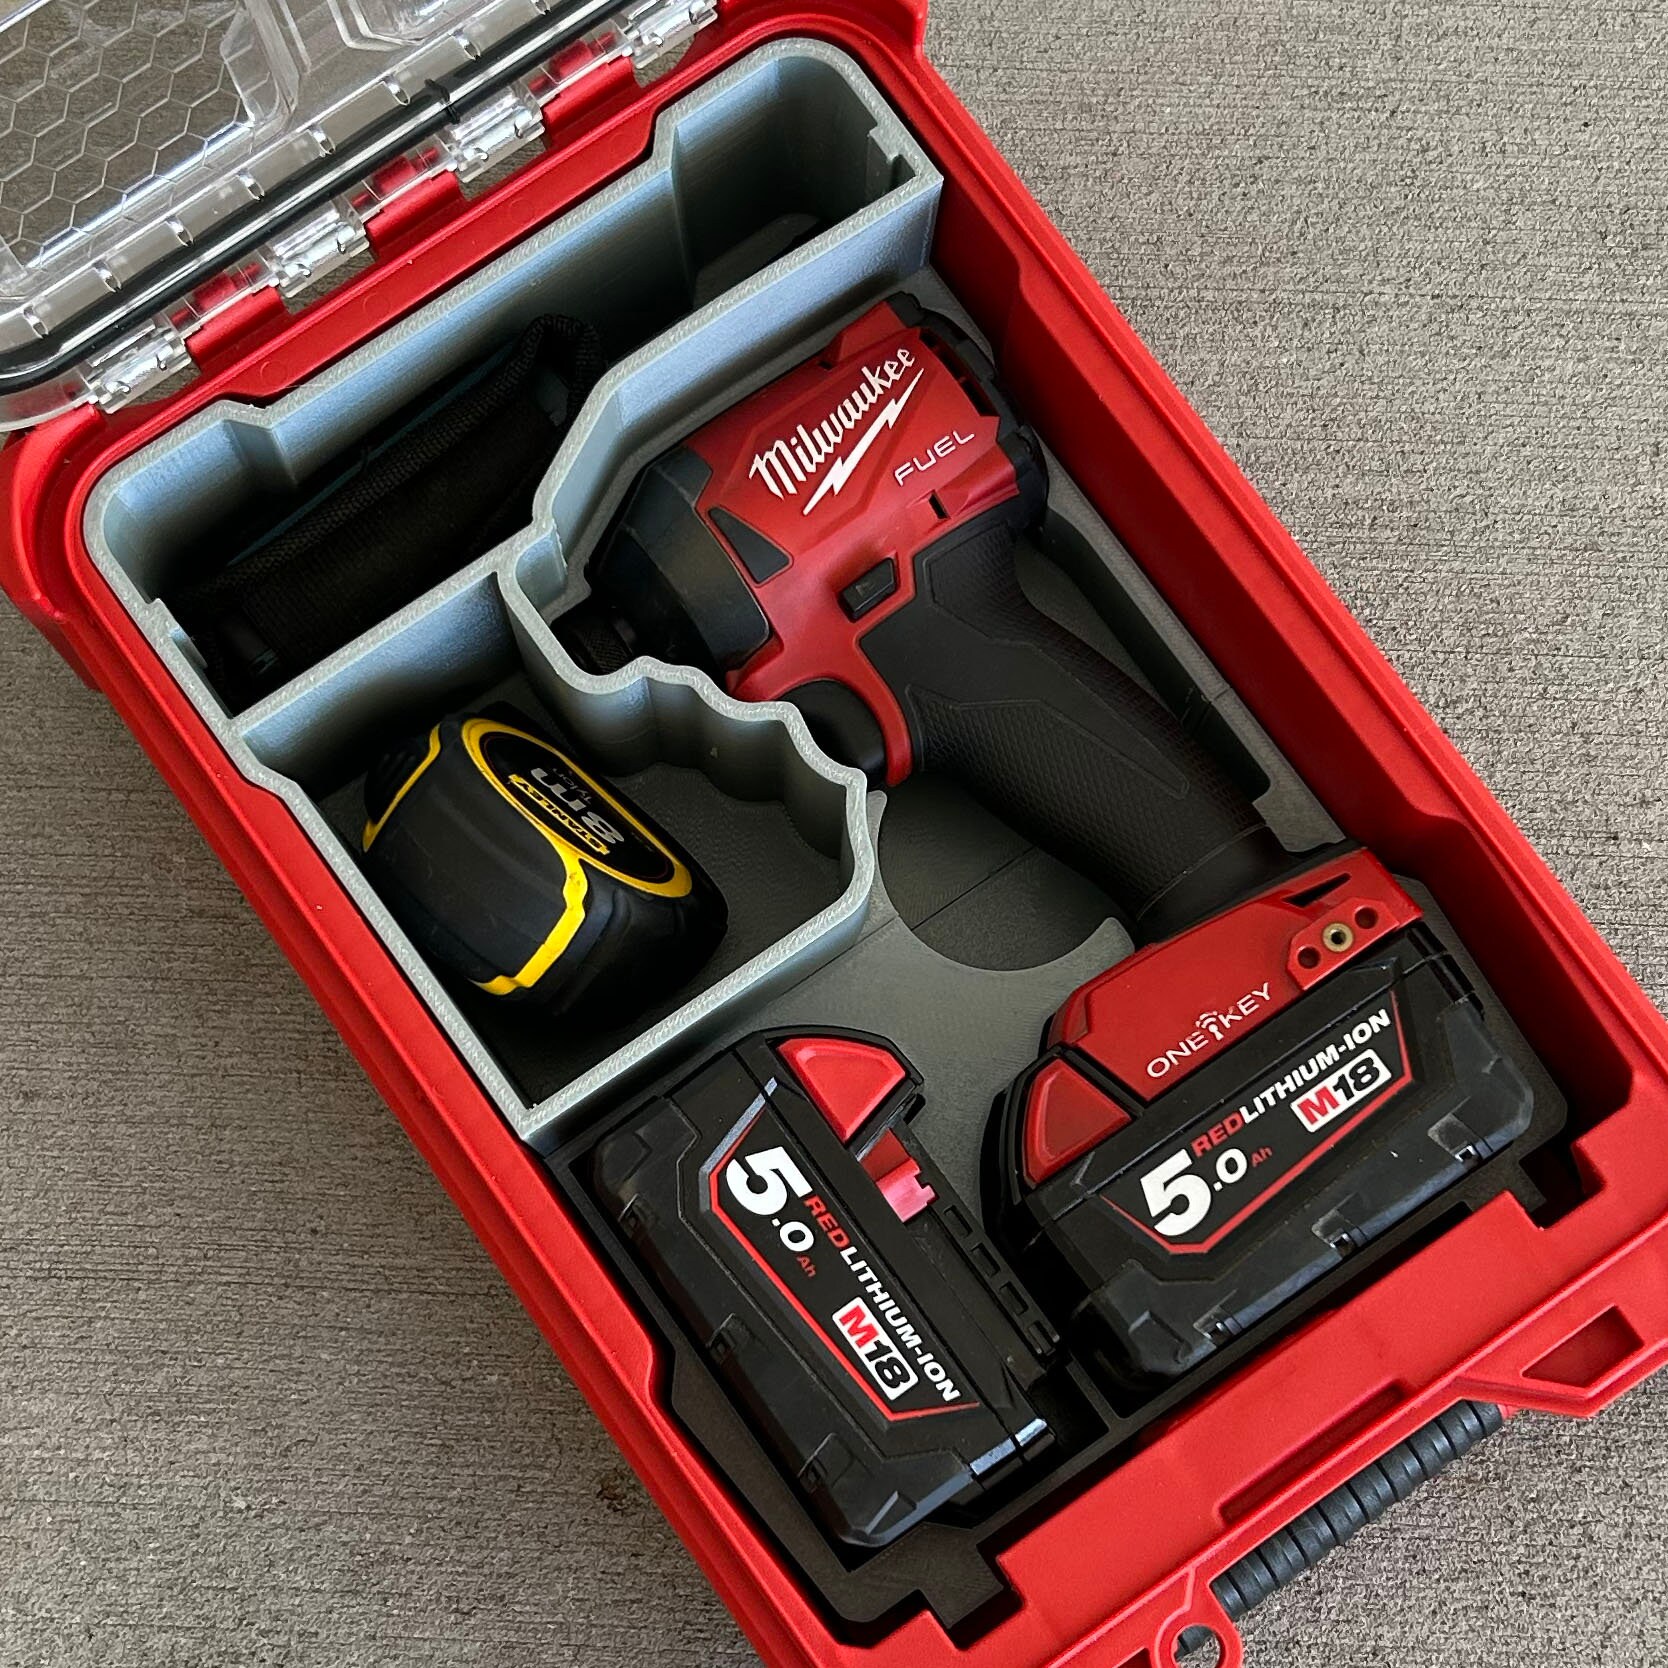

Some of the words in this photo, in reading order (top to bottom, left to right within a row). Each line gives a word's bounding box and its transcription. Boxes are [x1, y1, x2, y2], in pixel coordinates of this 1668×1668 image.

[748, 348, 915, 500] Milwaukee
[894, 430, 975, 487] FUEL
[514, 779, 603, 850] STANLEY
[530, 768, 625, 844] 8m
[1297, 1056, 1380, 1125] M18
[726, 1146, 815, 1252] 5.0
[796, 1254, 817, 1278] Ah
[1140, 1148, 1248, 1237] 5.0
[1250, 1147, 1273, 1167] Ah
[839, 1305, 911, 1389] M18
